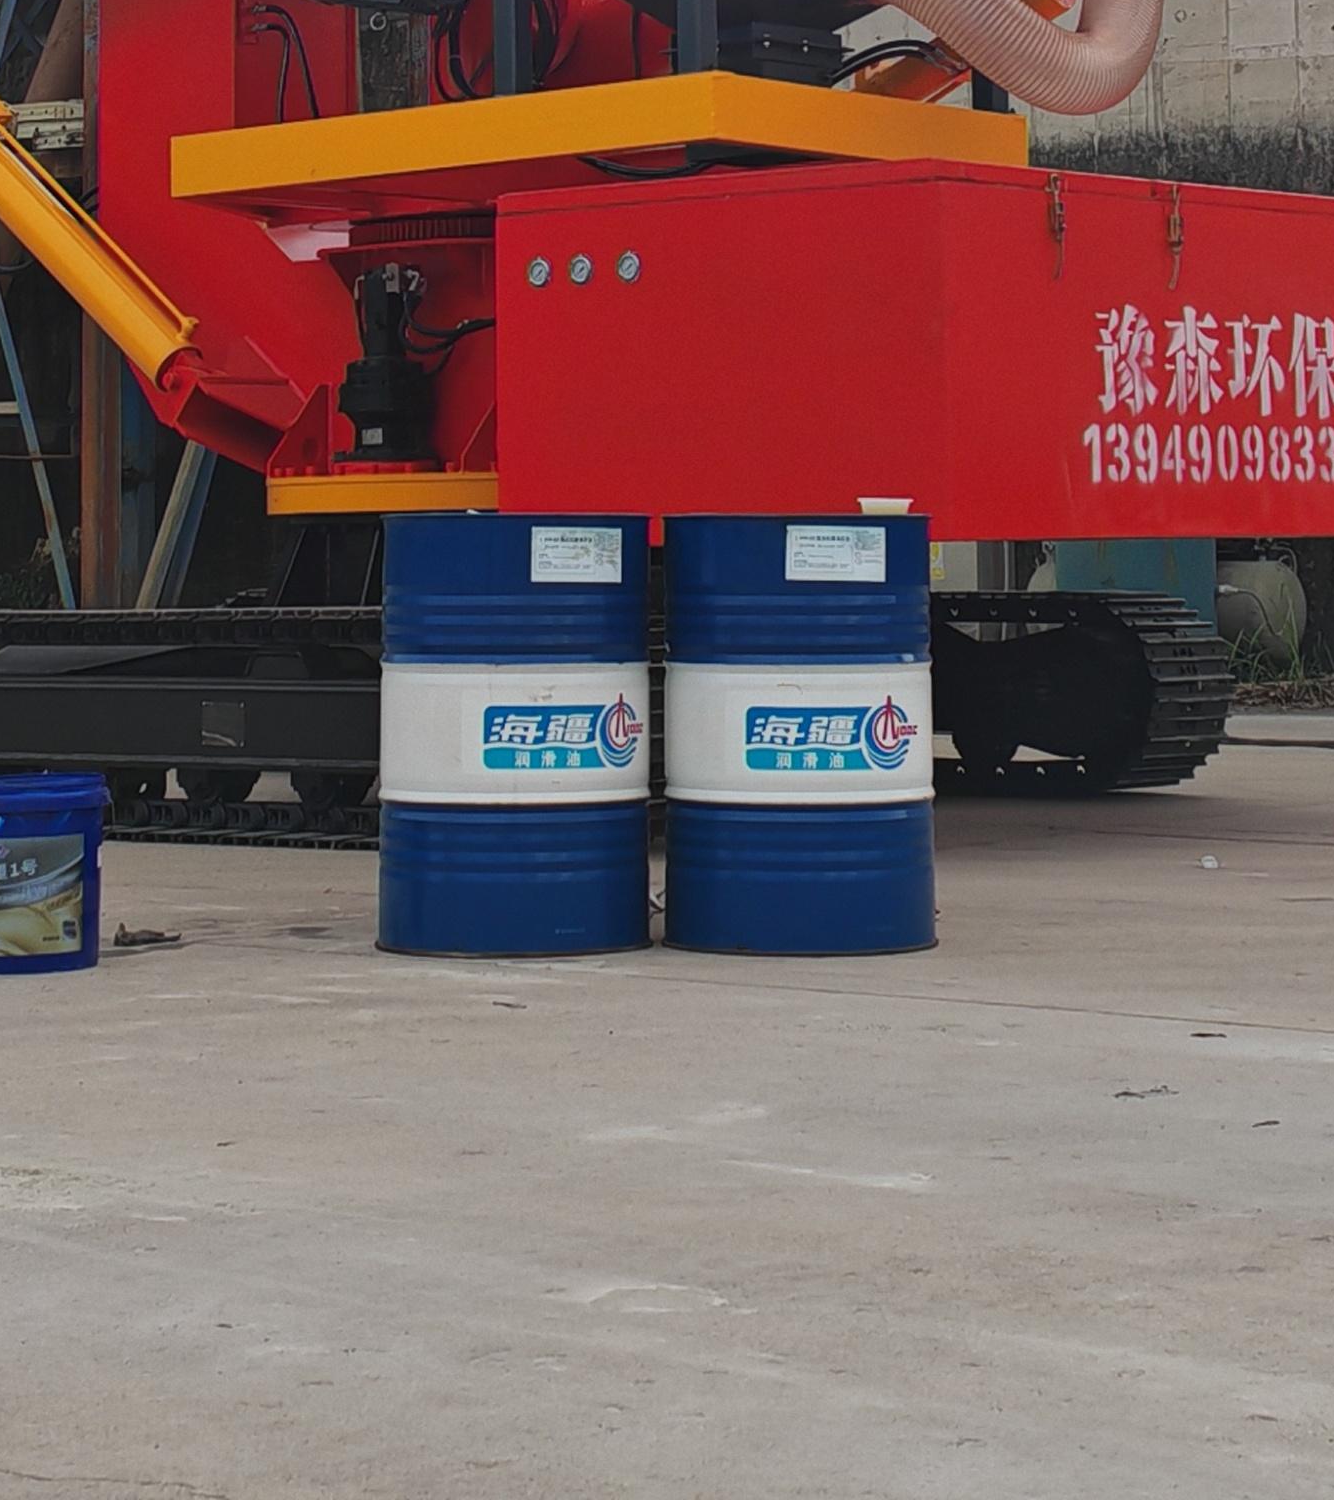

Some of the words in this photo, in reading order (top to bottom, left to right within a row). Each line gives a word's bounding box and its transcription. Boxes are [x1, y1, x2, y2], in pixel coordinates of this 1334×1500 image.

[488, 712, 594, 745] 海疆
[750, 714, 858, 746] 海疆
[514, 750, 581, 768] 润滑油
[775, 751, 845, 769] 润滑油
